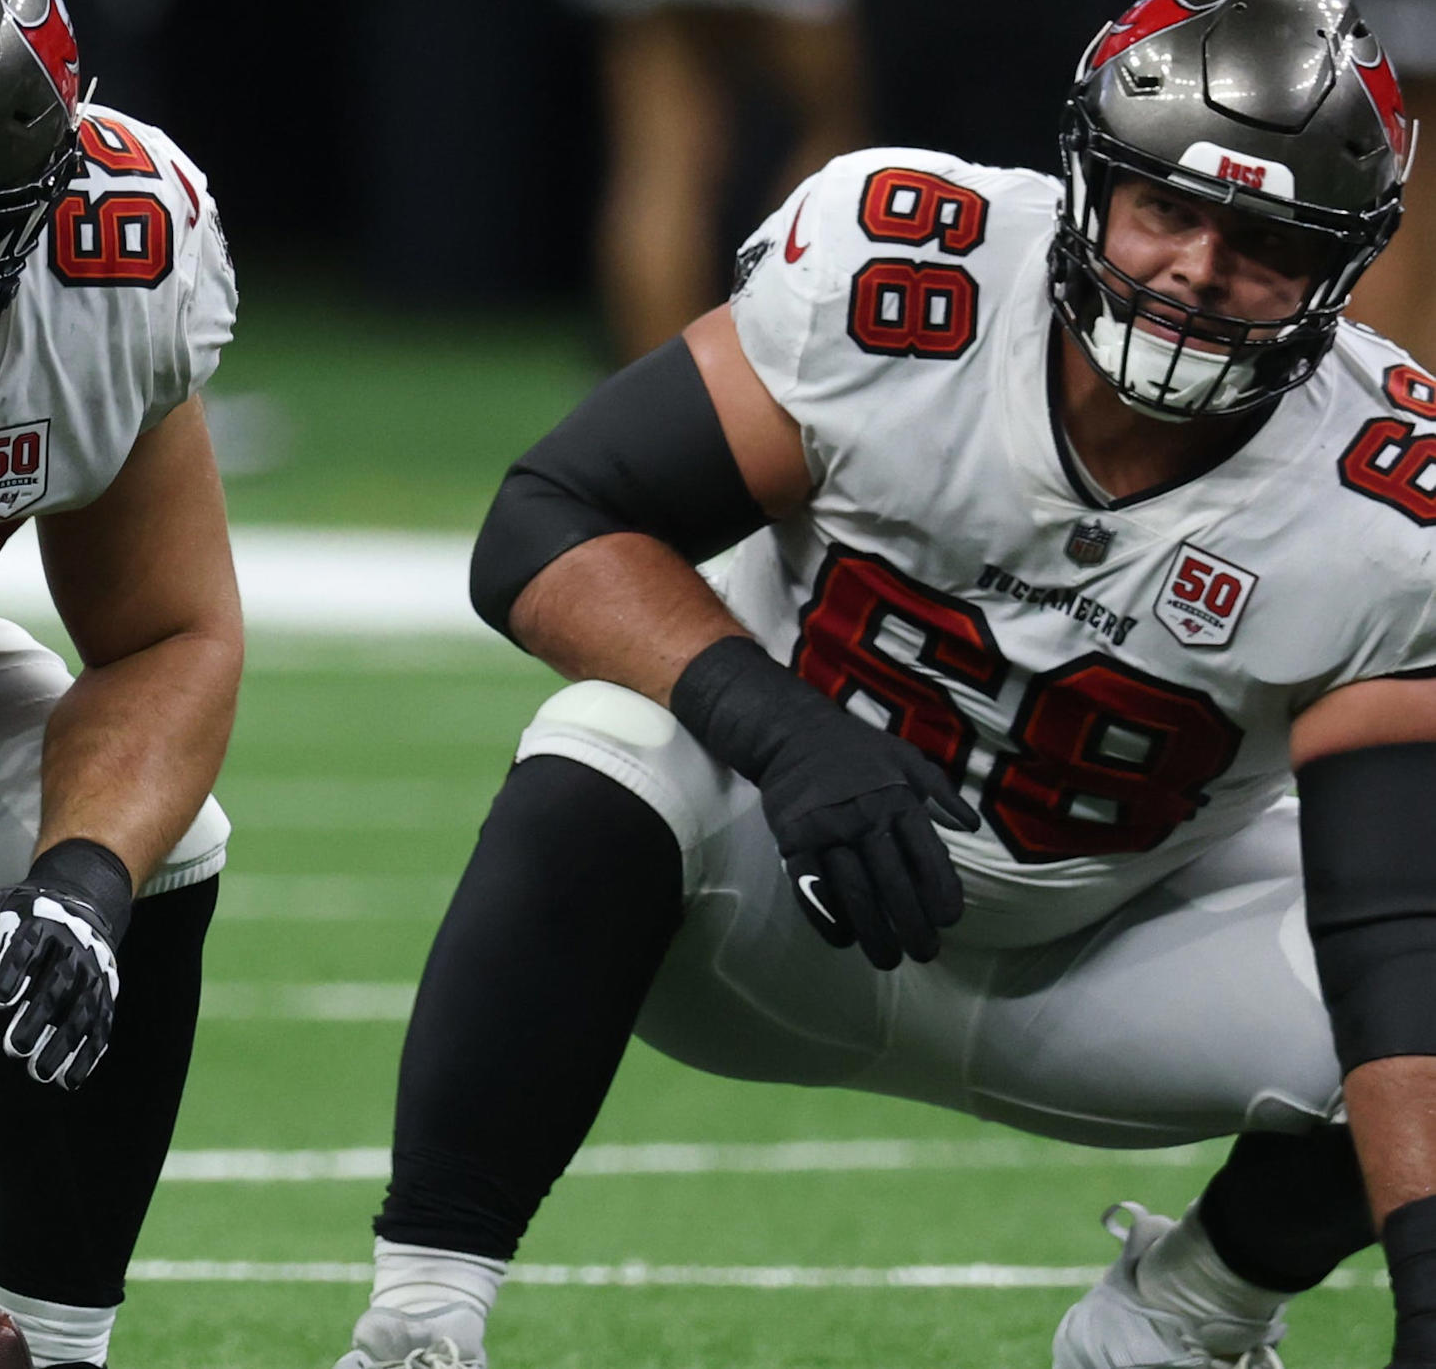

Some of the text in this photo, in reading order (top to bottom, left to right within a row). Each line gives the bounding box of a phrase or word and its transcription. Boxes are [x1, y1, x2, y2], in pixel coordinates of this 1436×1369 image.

[847, 166, 990, 361] 68
[977, 563, 1138, 647] BUCCANEERS
[1171, 556, 1242, 618] 50
[792, 541, 1245, 864] 68
